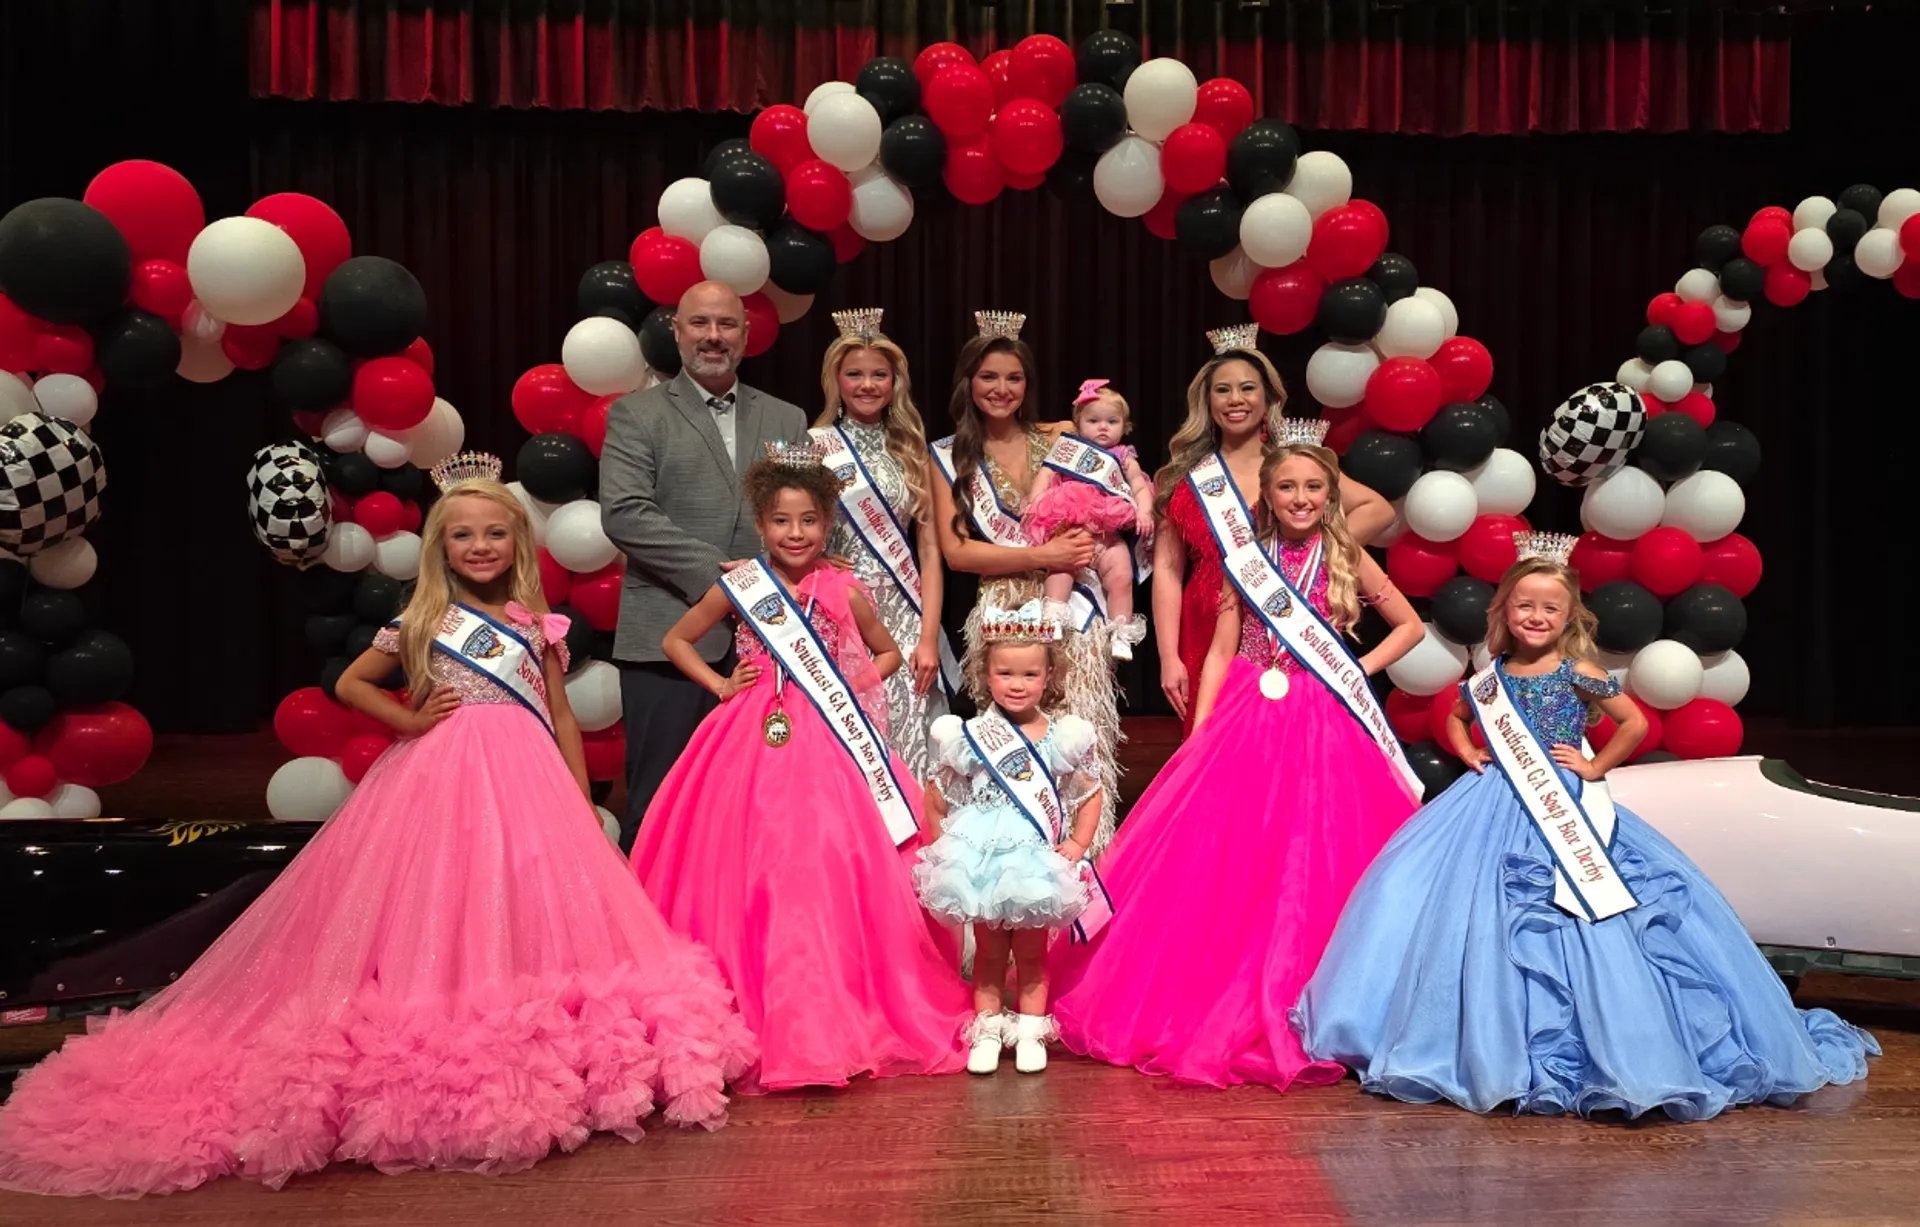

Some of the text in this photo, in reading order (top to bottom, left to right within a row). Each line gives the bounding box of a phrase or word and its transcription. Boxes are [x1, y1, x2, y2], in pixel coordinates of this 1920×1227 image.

[857, 497, 894, 543] Southeast
[888, 540, 904, 559] GA
[727, 561, 759, 585] YOUNG
[738, 575, 760, 592] MISS
[1240, 560, 1266, 588] JUNIOR
[1251, 571, 1268, 588] MISS
[1299, 624, 1346, 674] Southeast
[1341, 669, 1360, 691] GA
[1353, 686, 1370, 715] Soap
[789, 637, 895, 802] Southeast GA Soap Box Derby
[979, 722, 1007, 745] TINY
[987, 732, 1015, 753] MISS
[1494, 712, 1607, 883] Southeast GA Soap Box Derby
